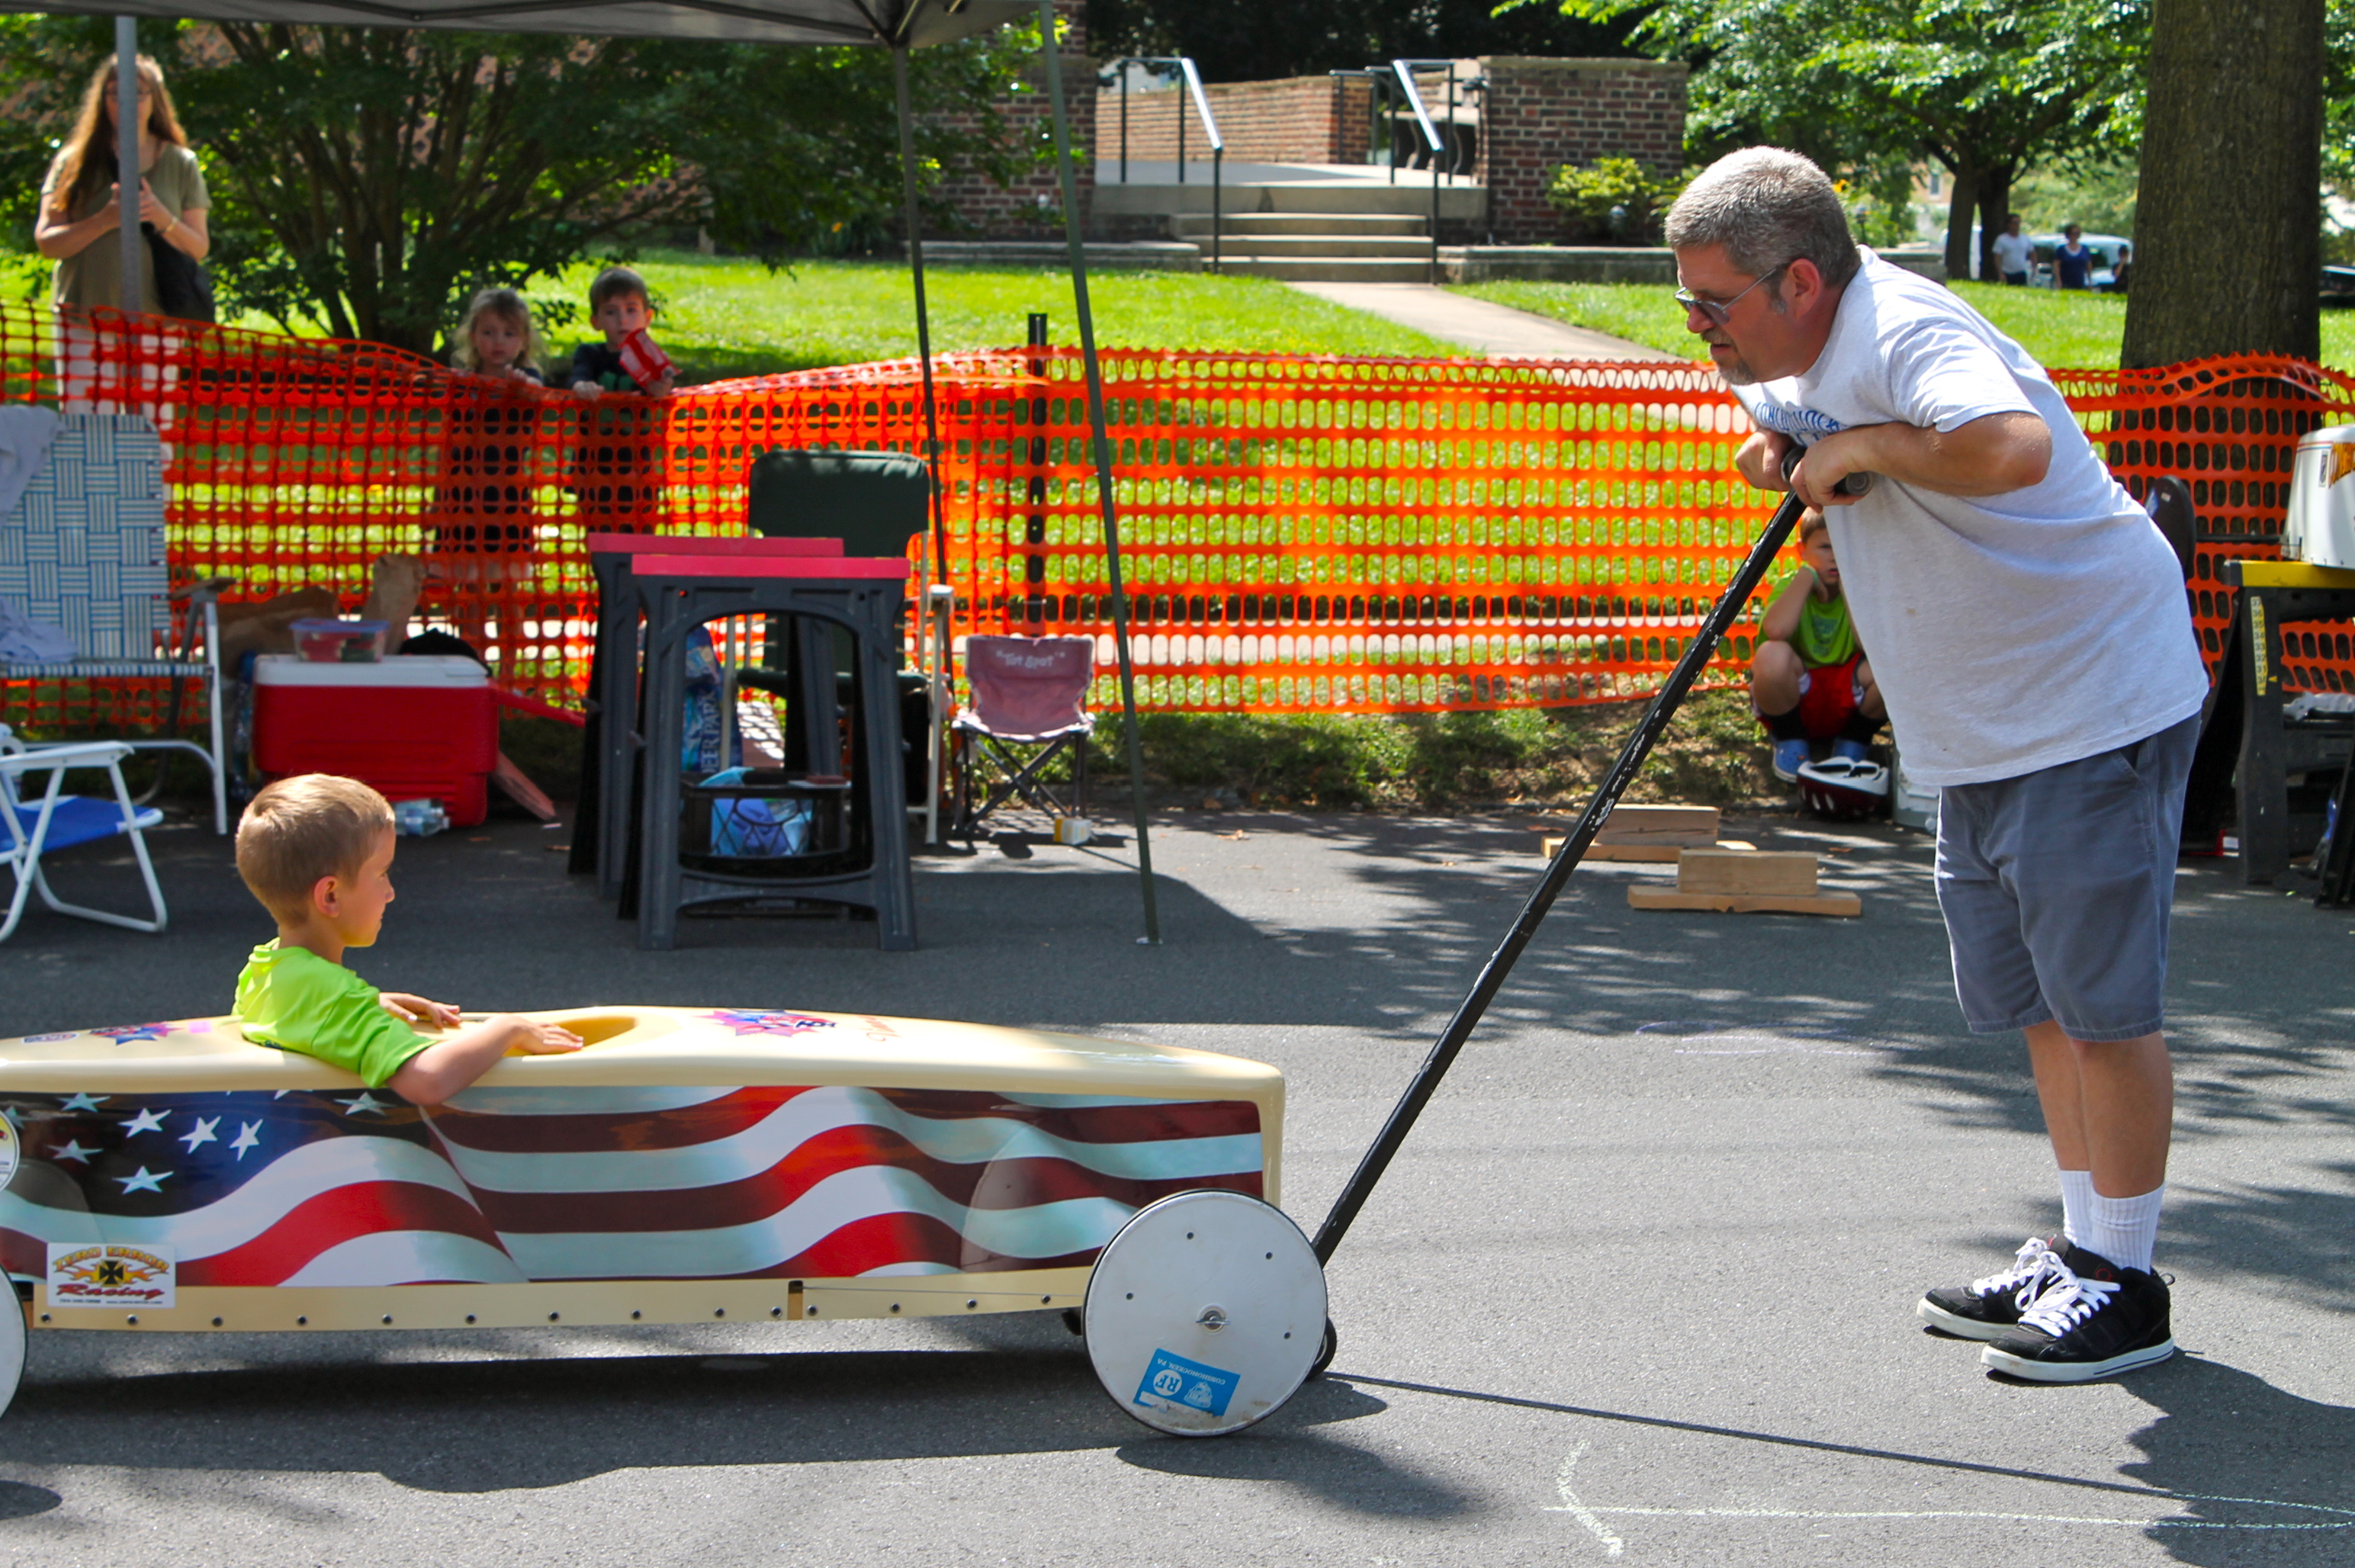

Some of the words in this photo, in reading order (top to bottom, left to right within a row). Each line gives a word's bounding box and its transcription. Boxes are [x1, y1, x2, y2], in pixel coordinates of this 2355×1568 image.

[701, 690, 720, 734] PARK
[53, 1246, 101, 1272] ZERO
[107, 1246, 169, 1272] ERROR
[56, 1284, 165, 1300] Racing
[1157, 1358, 1167, 1367] PA
[1155, 1374, 1181, 1393] RF
